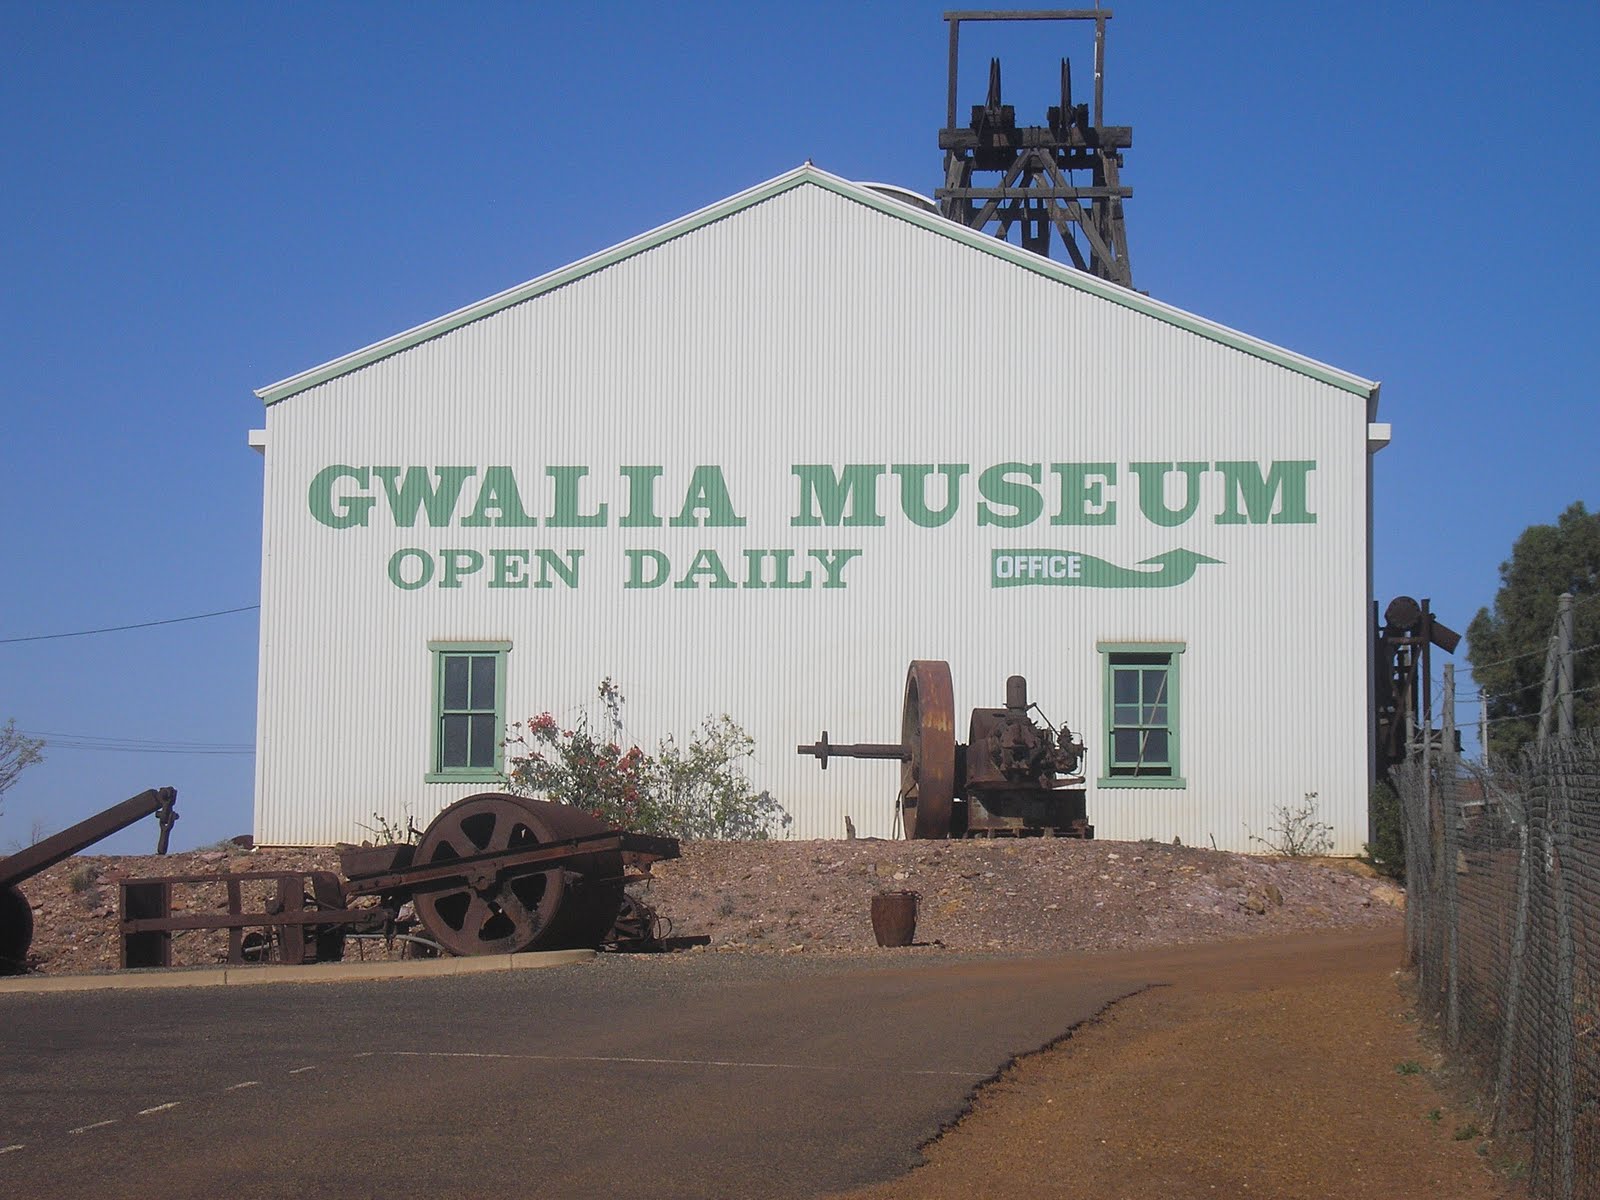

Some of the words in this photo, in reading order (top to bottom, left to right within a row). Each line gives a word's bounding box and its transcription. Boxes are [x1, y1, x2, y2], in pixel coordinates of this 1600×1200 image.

[308, 464, 747, 529] GWALIA
[791, 460, 1318, 528] MUSEUM
[388, 548, 584, 590] OPEN
[624, 548, 863, 589] DAILY
[995, 555, 1082, 579] OFFICE
